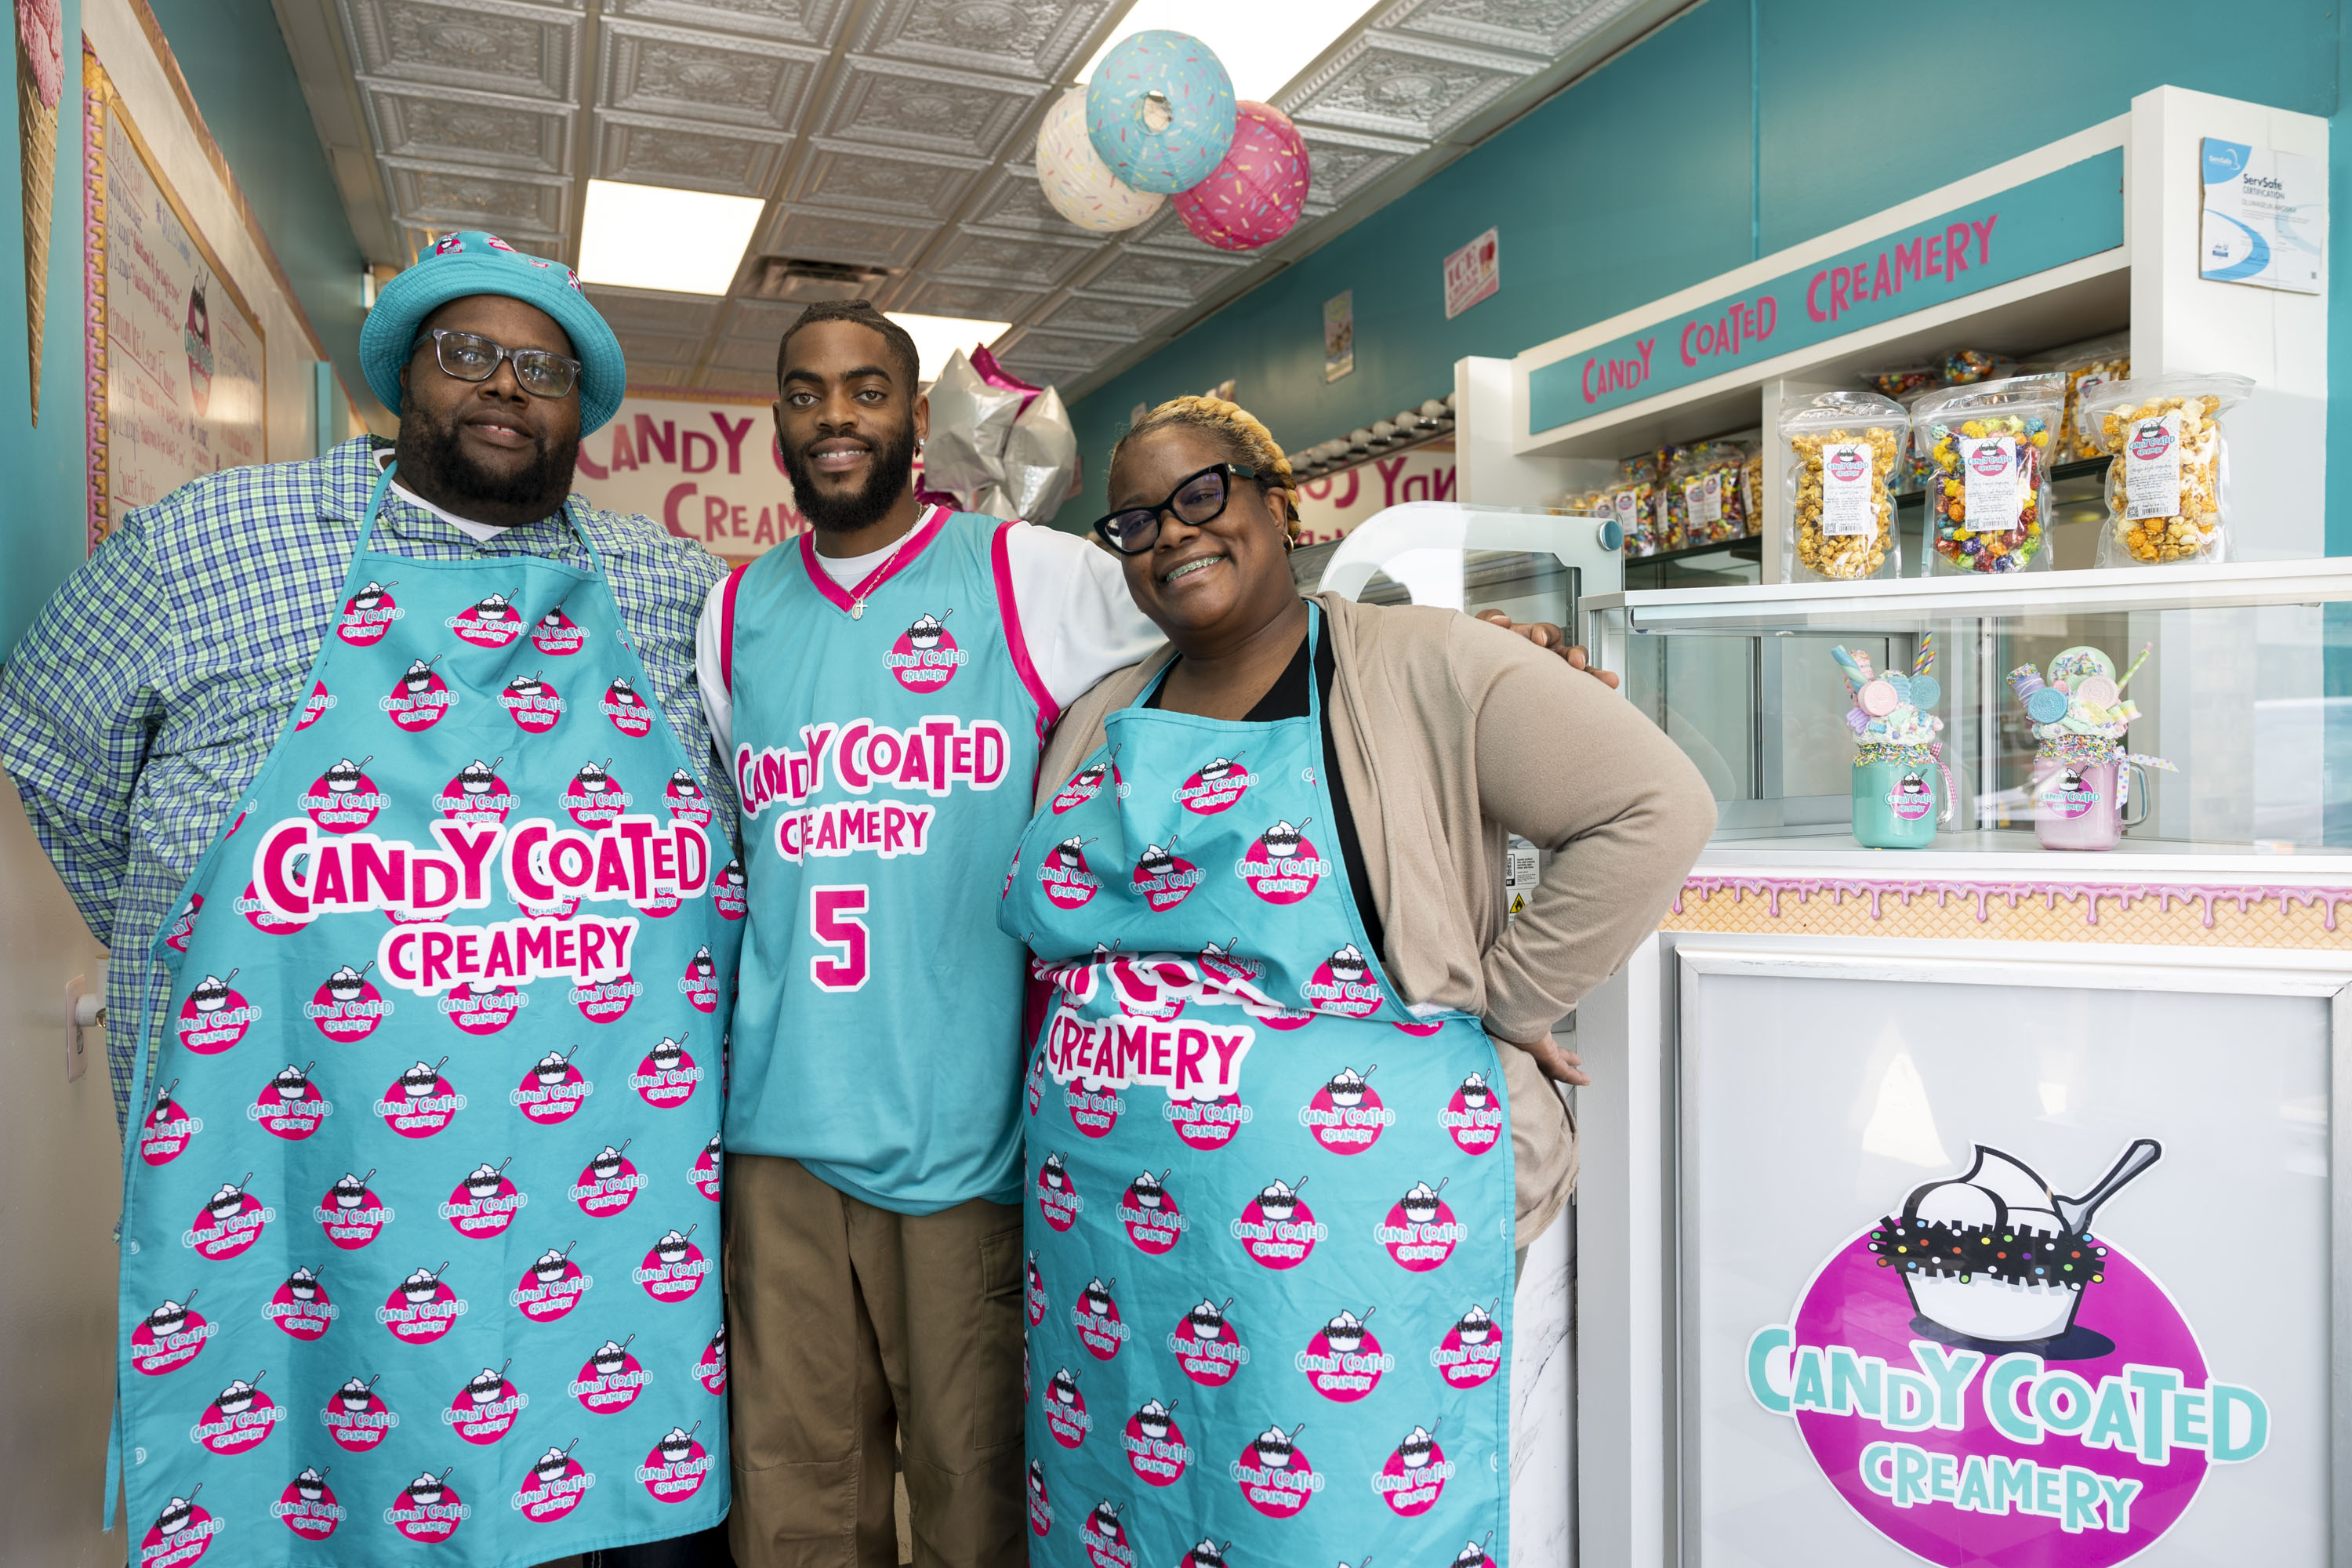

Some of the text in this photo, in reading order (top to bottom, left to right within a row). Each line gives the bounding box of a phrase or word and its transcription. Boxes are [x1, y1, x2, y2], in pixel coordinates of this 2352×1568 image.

[2243, 173, 2283, 191] ServSafe
[2242, 185, 2285, 200] CERTIFICATION
[1582, 213, 1999, 405] CANDY COATED CREAMERY
[446, 616, 528, 635] CANDY COATED
[463, 629, 506, 642] CREAMERY
[884, 649, 967, 668] CANDY COATED
[902, 670, 947, 681] CREAMERY
[379, 691, 459, 711] CANDY COATED
[498, 696, 565, 712] CANDY COATED
[399, 710, 437, 722] CREAMERY
[517, 711, 554, 724] CREAMERY
[739, 722, 1004, 814] CANDY COATED
[1174, 774, 1258, 801] CANDY COATED
[299, 794, 390, 810] CANDY COATED
[560, 793, 632, 808] CANDY COATED
[1192, 791, 1236, 807] CREAMERY
[1885, 793, 1935, 804] CANDY COATED
[2068, 792, 2100, 803] COATED
[319, 812, 368, 822] CREAMERY
[579, 811, 616, 820] CREAMERY
[780, 807, 929, 859] CREAMERY
[263, 822, 707, 922] CANDY COATED
[1236, 859, 1330, 878] CANDY COATED
[1258, 880, 1308, 892] CREAMERY
[815, 890, 866, 987] 5
[388, 923, 632, 987] CREAMERY
[570, 982, 642, 1004] CANDY COATED
[305, 1000, 394, 1018] CANDY COATED
[588, 1002, 624, 1014] CREAMERY
[325, 1020, 372, 1032] CREAMERY
[1048, 1014, 1245, 1090] CREAMERY
[630, 1068, 703, 1090] CANDY COATED
[510, 1082, 593, 1105] CANDY COATED
[648, 1087, 688, 1099] CREAMERY
[374, 1094, 466, 1117] CANDY COATED
[530, 1102, 575, 1116] CREAMERY
[1163, 1103, 1252, 1122] CANDY COATED
[397, 1116, 445, 1128] CREAMERY
[1300, 1107, 1395, 1126] CANDY COATED
[1184, 1125, 1229, 1138] CREAMERY
[1321, 1130, 1372, 1142] CREAMERY
[569, 1175, 648, 1200] CANDY COATED
[439, 1194, 527, 1218] CANDY COATED
[587, 1195, 628, 1209] CREAMERY
[314, 1207, 394, 1224] CANDY COATED
[461, 1215, 508, 1229] CREAMERY
[1116, 1203, 1189, 1230] CANDY COATED
[183, 1208, 275, 1247] CANDY COATED
[331, 1227, 372, 1238] CREAMERY
[1134, 1226, 1172, 1243] CREAMERY
[1231, 1219, 1327, 1240] CANDY COATED
[1374, 1224, 1466, 1243] CANDY COATED
[206, 1231, 254, 1253] CREAMERY
[1254, 1243, 1304, 1256] CREAMERY
[1398, 1246, 1446, 1258] CREAMERY
[510, 1277, 593, 1305] CANDY COATED
[529, 1298, 572, 1314] CREAMERY
[1167, 1334, 1249, 1363] CANDY COATED
[1186, 1358, 1229, 1376] CREAMERY
[1296, 1354, 1394, 1372] CANDY COATED
[569, 1371, 652, 1396] CANDY COATED
[1318, 1377, 1370, 1388] CREAMERY
[589, 1391, 633, 1406] CREAMERY
[1748, 1328, 2268, 1461] CANDY COATED
[191, 1407, 286, 1442] CANDY COATED
[213, 1429, 264, 1447] CREAMERY
[636, 1457, 714, 1482] CANDY COATED
[1230, 1461, 1323, 1491] CANDY COATED
[1372, 1461, 1454, 1494] CANDY COATED
[655, 1479, 697, 1494] CREAMERY
[1864, 1446, 2136, 1530] CREAMERY
[1250, 1489, 1300, 1507] CREAMERY
[1395, 1487, 1436, 1507] CREAMERY
